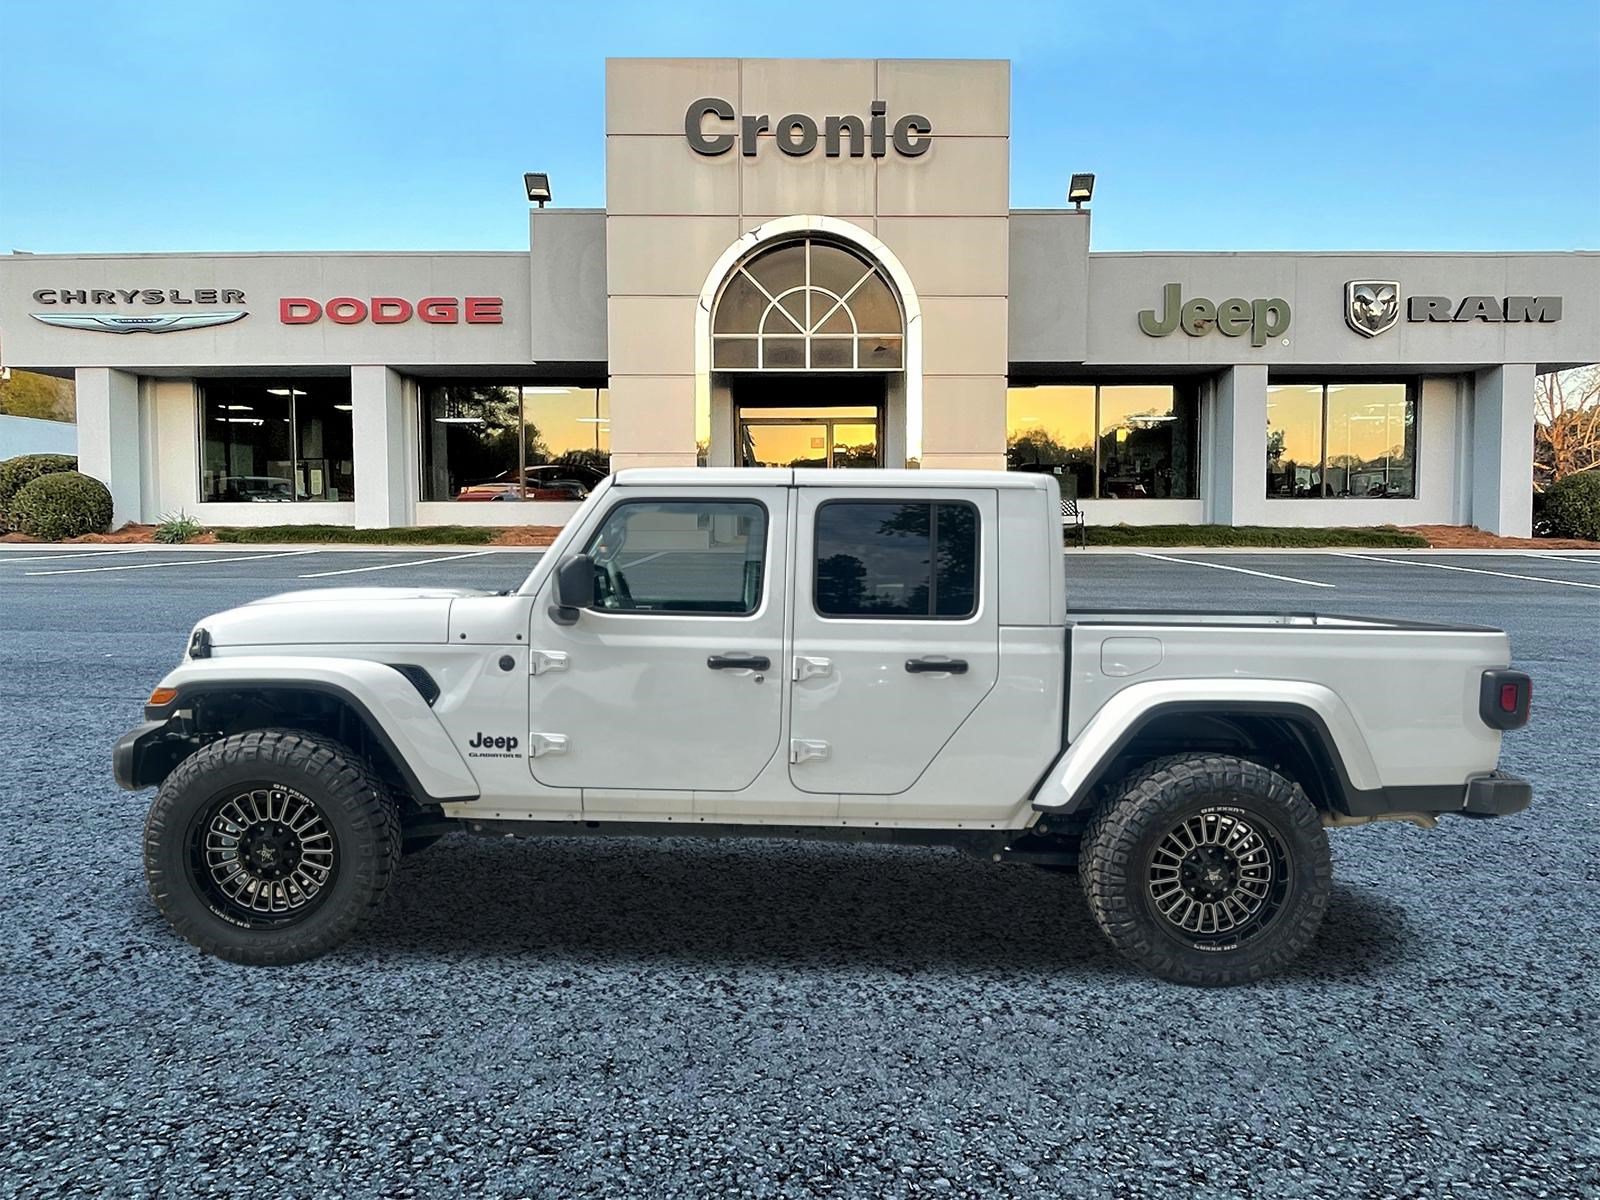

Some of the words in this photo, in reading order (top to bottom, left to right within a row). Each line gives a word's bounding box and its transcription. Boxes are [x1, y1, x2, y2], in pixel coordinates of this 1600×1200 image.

[684, 97, 933, 158] Cronic
[32, 288, 247, 305] CHRYSLER
[1407, 296, 1563, 323] RAM
[279, 297, 504, 325] DODGE
[1138, 283, 1292, 348] Jeep
[469, 731, 519, 752] Jeep
